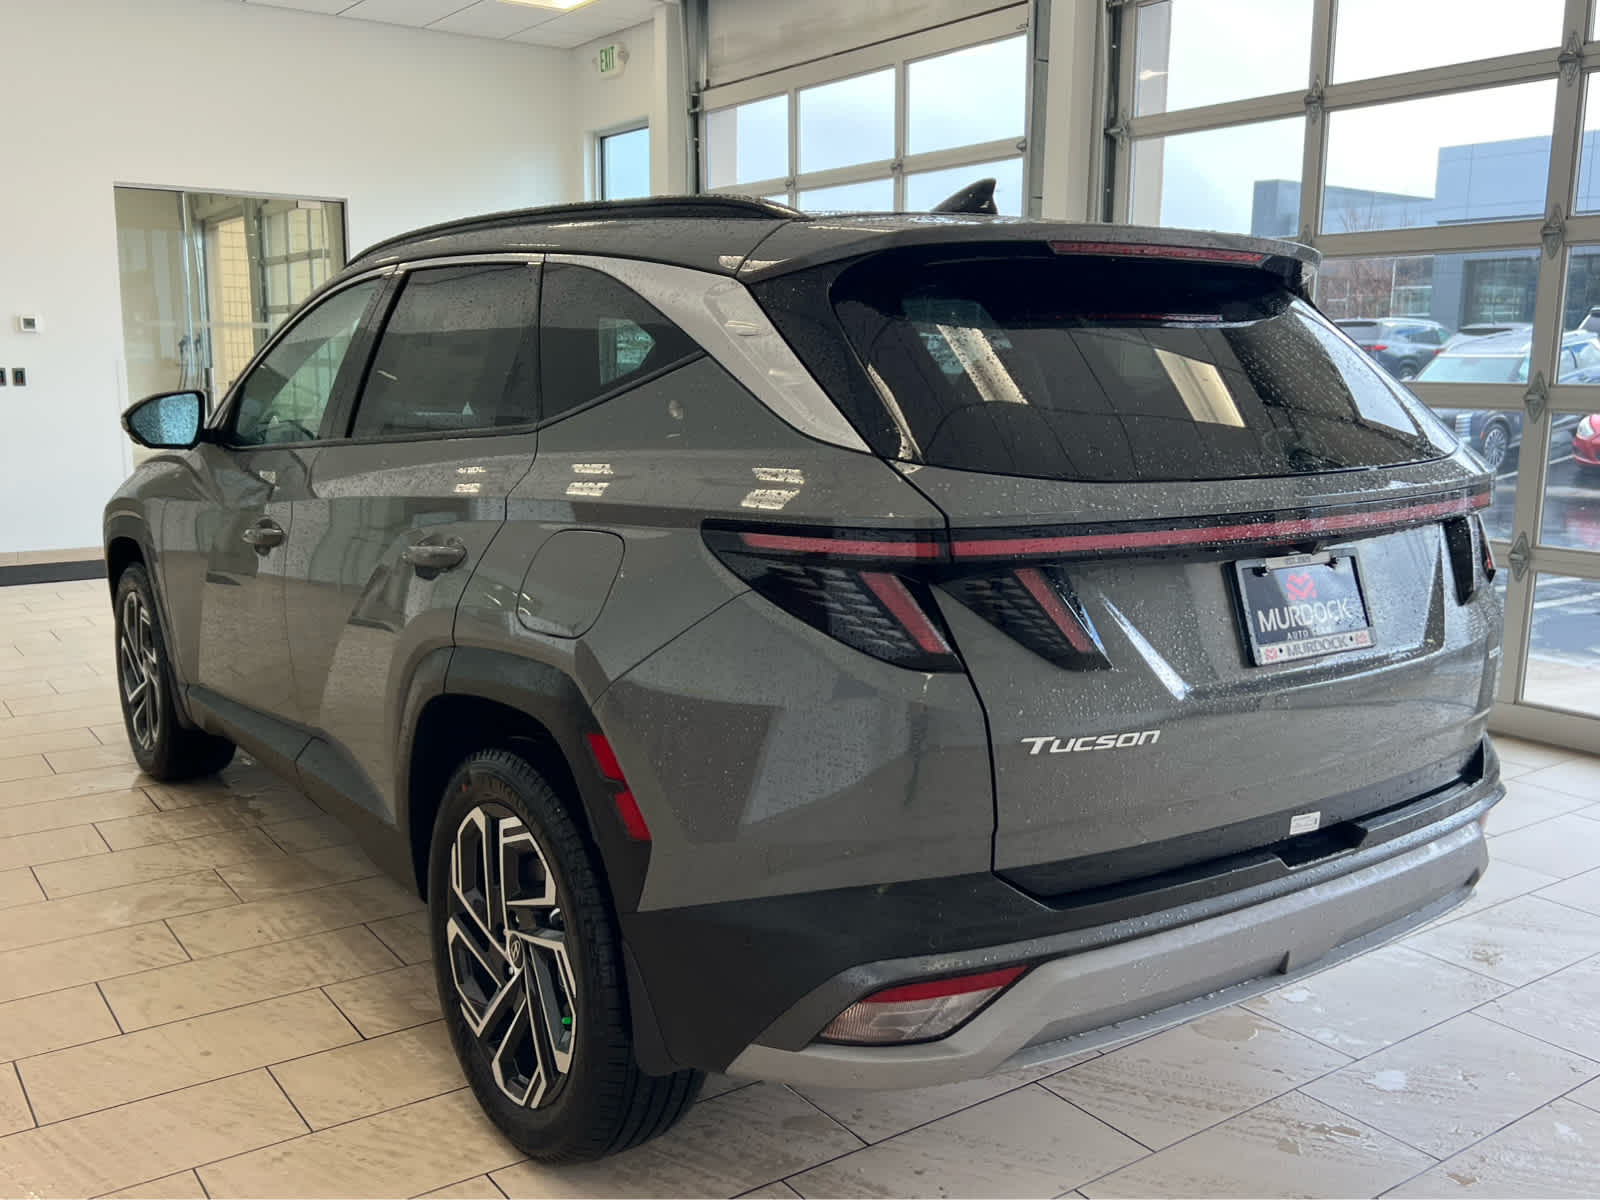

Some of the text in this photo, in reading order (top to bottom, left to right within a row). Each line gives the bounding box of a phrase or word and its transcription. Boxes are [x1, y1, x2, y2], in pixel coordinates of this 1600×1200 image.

[600, 46, 615, 72] EXIT
[1257, 599, 1352, 633] MURDOCK
[1286, 633, 1348, 657] MURDOCK
